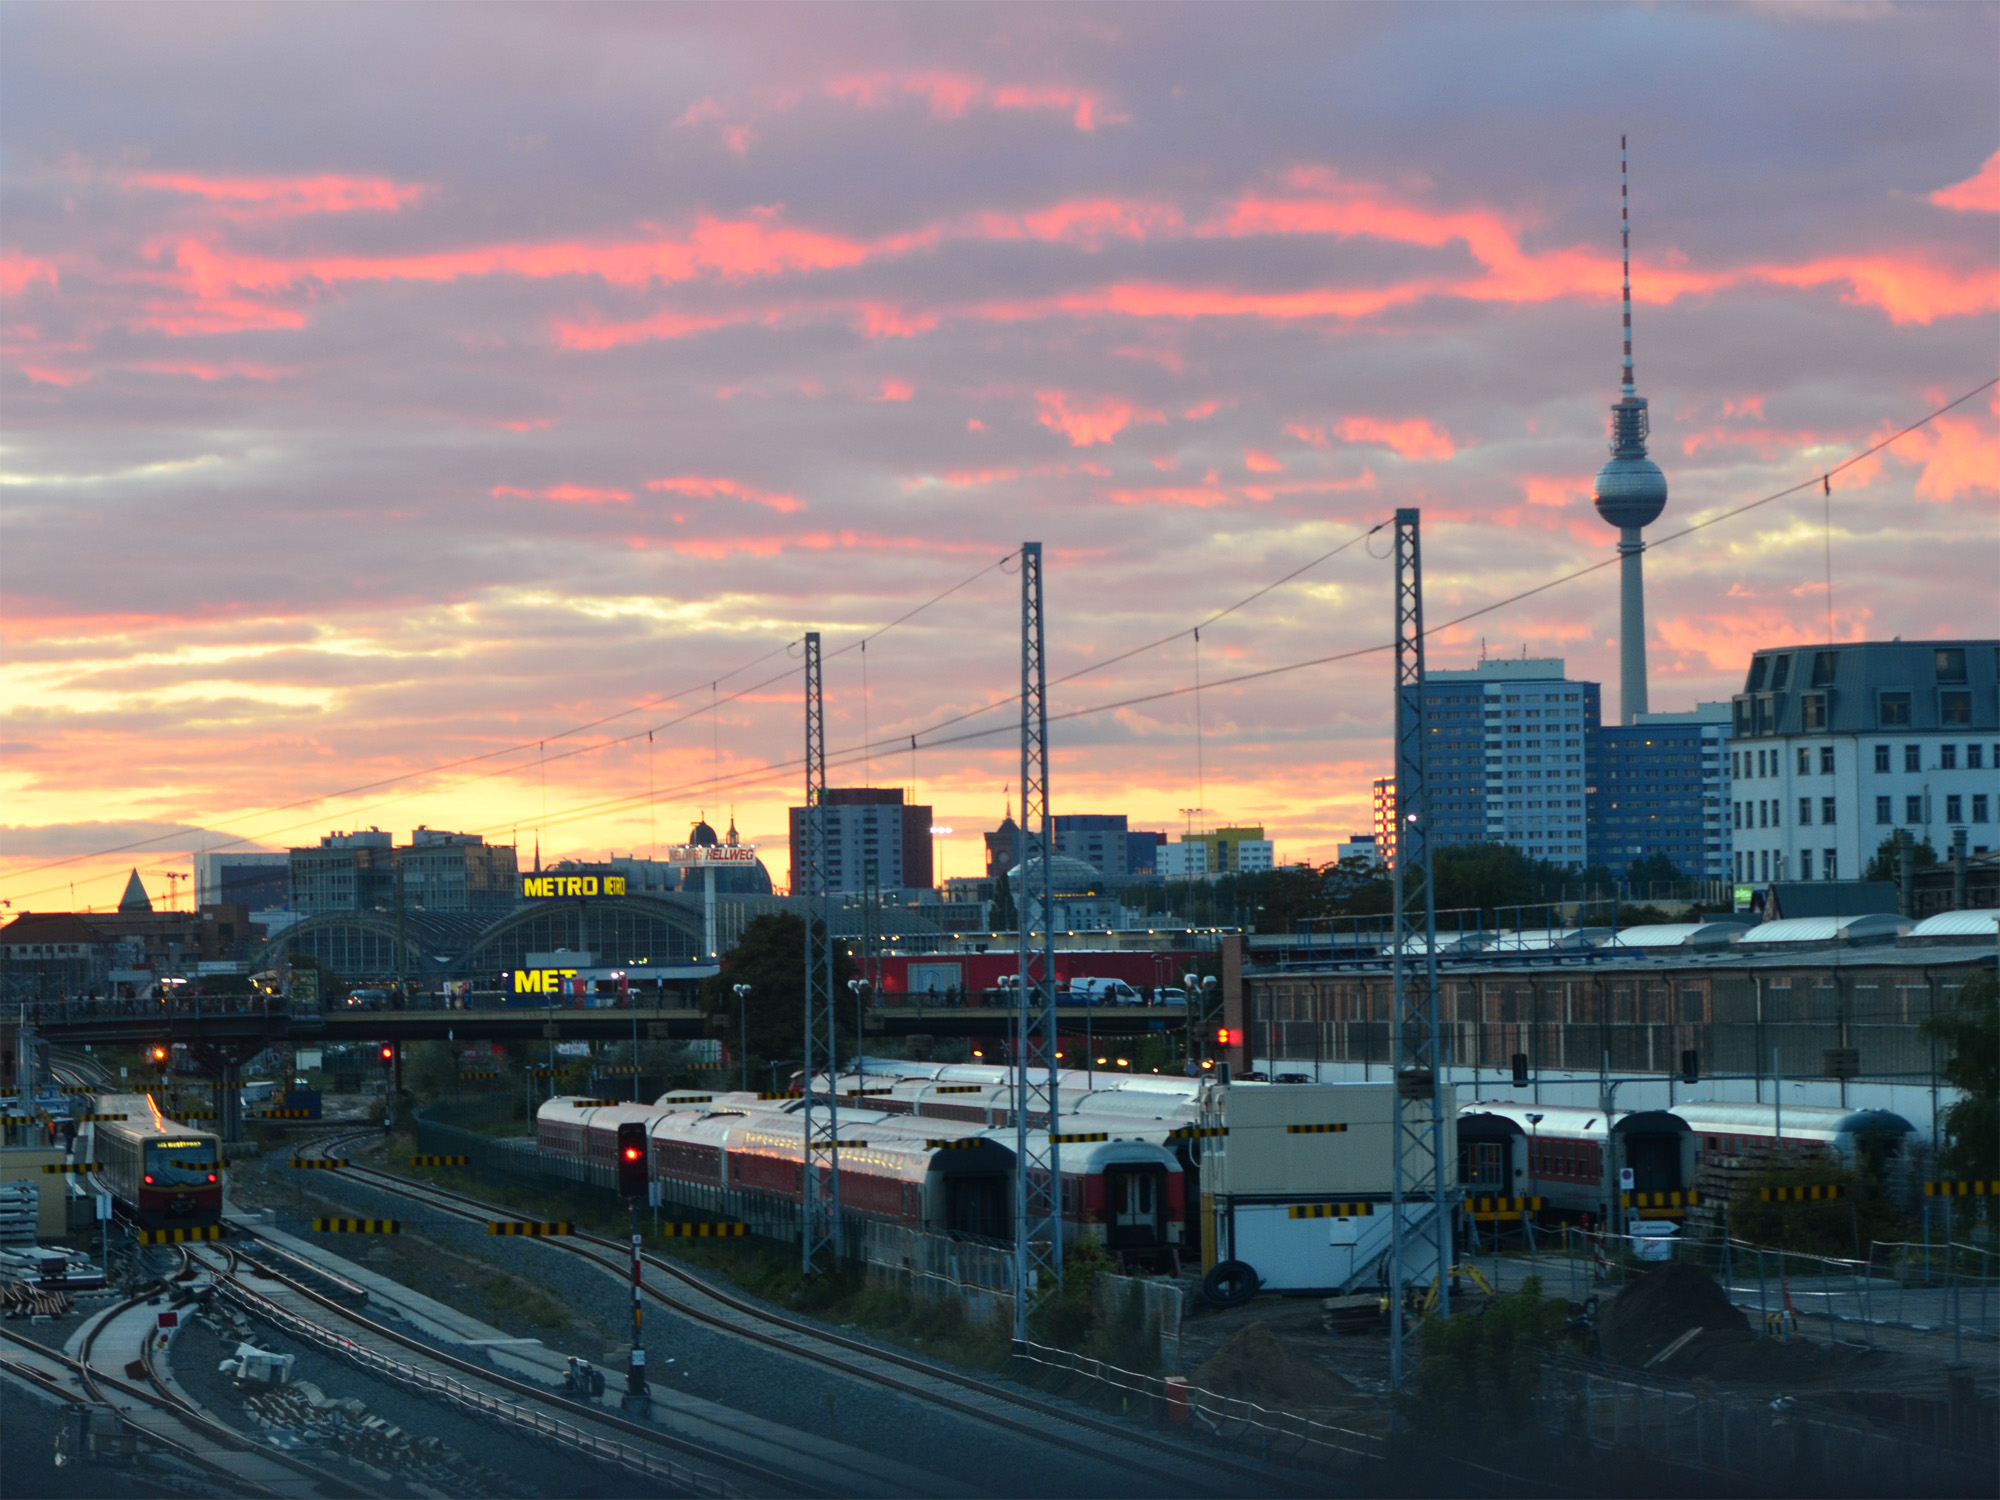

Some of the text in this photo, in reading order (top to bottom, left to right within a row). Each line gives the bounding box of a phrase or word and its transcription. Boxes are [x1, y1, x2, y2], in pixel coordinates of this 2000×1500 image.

[705, 849, 754, 861] HELLWEG
[524, 876, 598, 897] METRO
[603, 876, 626, 896] METRO
